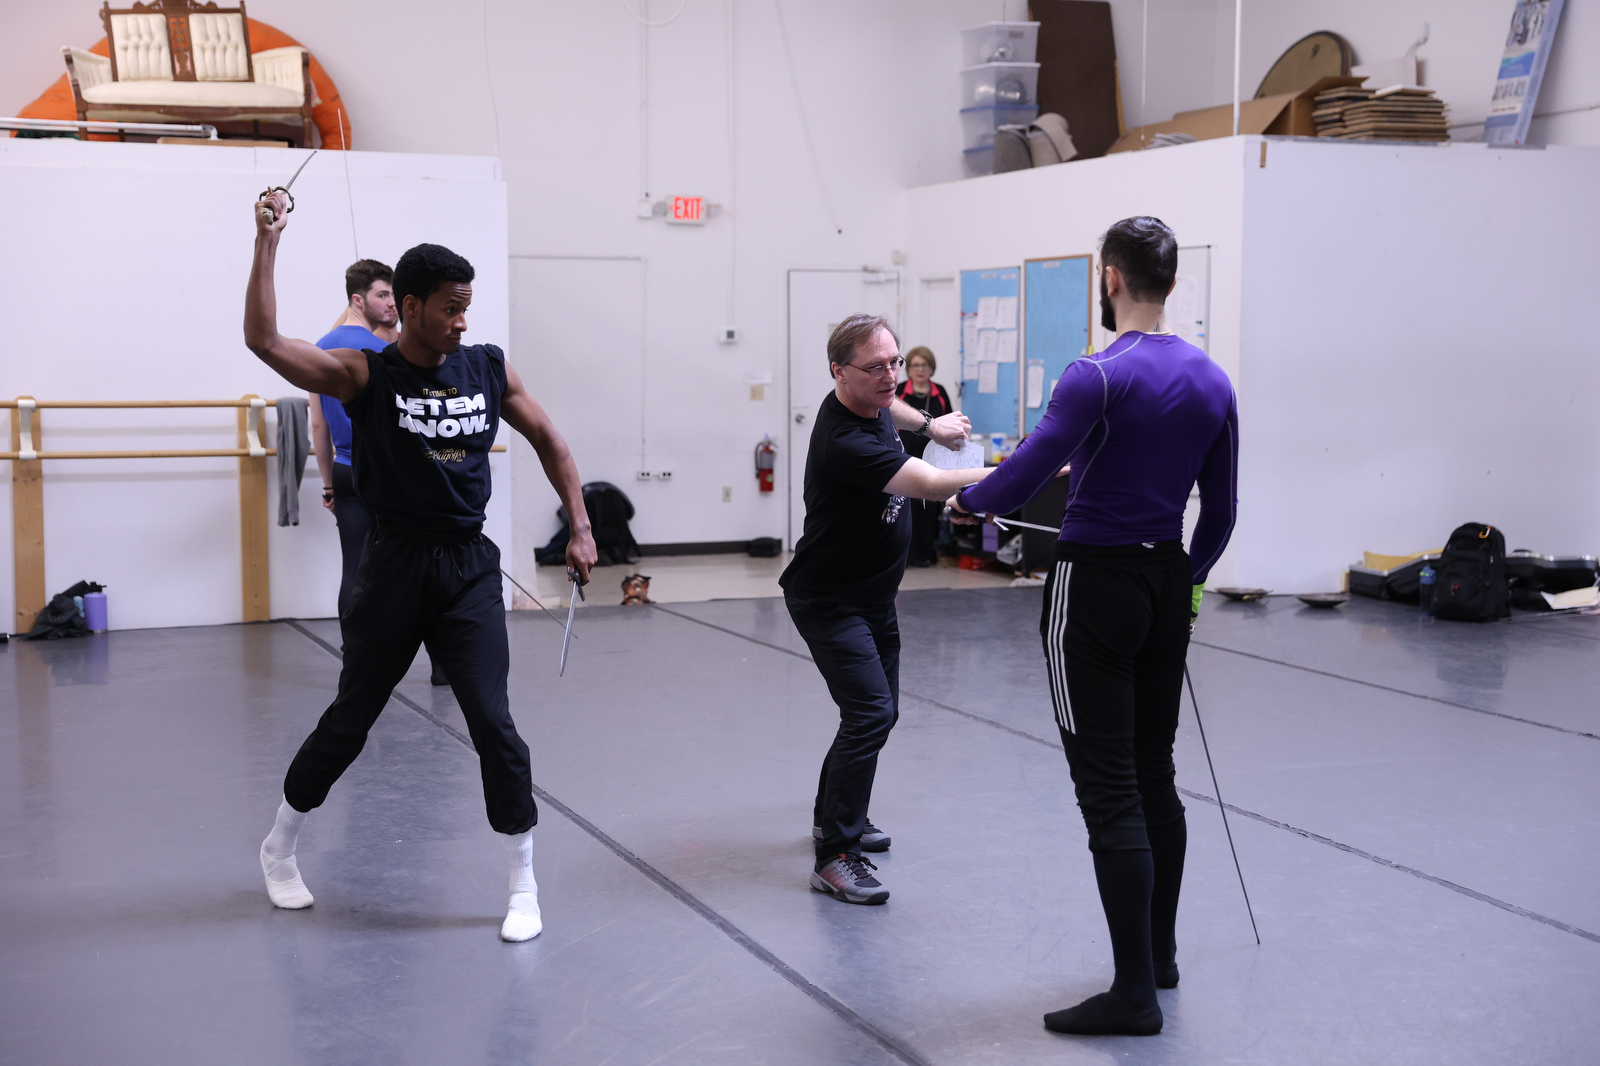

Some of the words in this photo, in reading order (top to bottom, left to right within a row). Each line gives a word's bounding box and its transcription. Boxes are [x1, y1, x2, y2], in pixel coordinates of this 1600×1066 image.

[674, 196, 702, 220] EXIT
[447, 387, 458, 396] TO
[444, 393, 486, 416] EM
